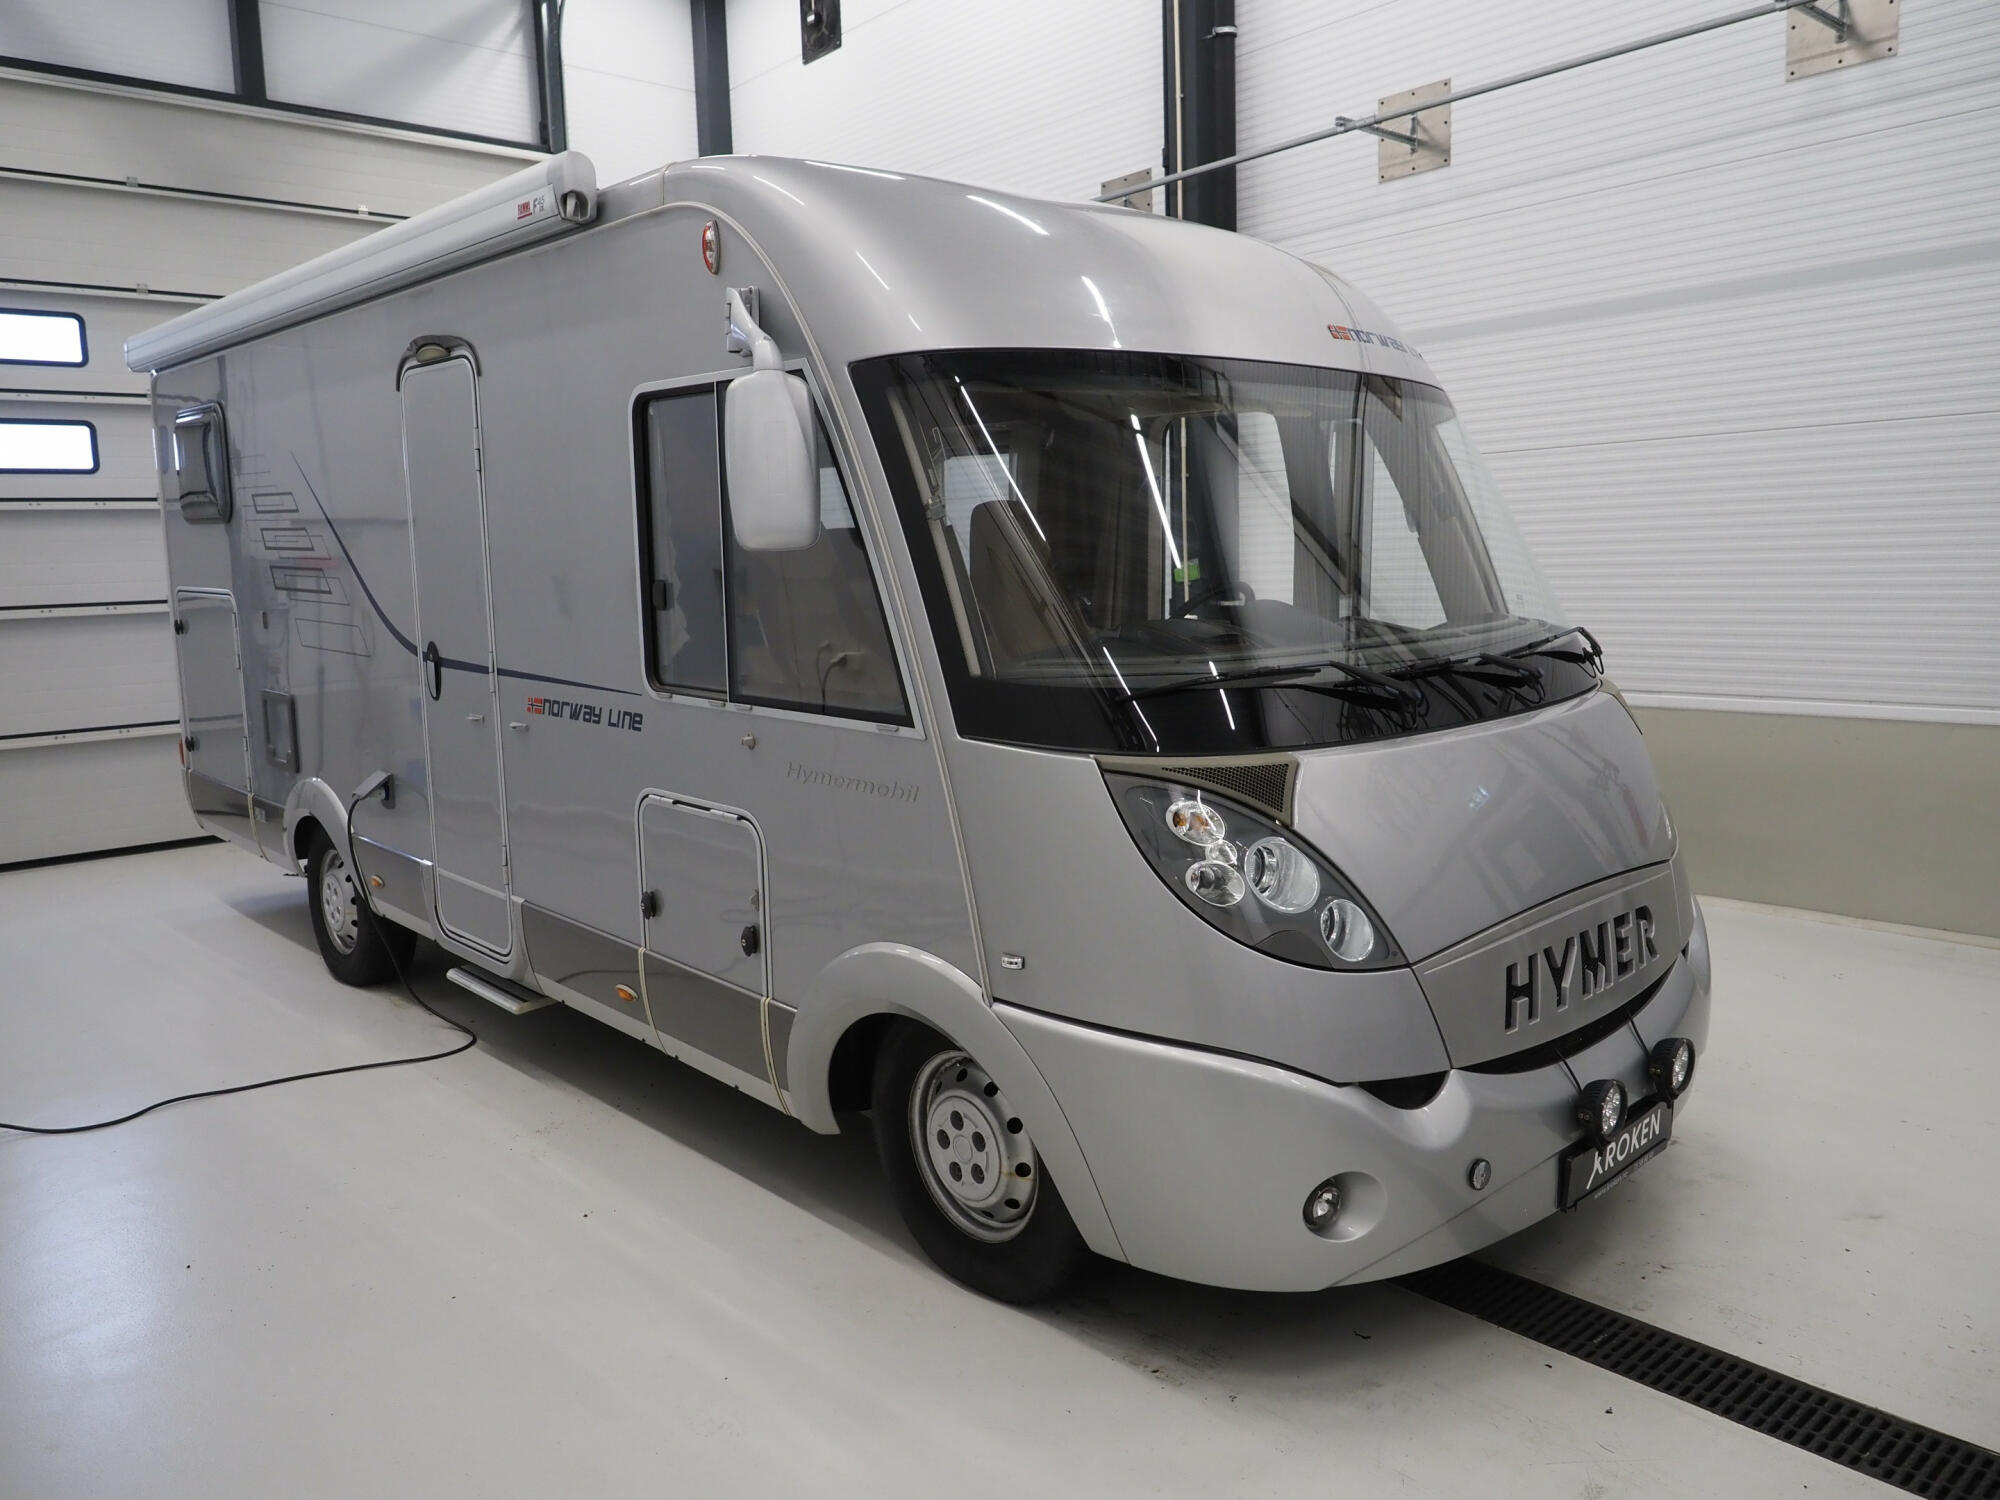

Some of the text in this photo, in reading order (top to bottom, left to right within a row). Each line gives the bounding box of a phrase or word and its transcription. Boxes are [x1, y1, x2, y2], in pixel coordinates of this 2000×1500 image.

[542, 698, 602, 725] norway
[785, 761, 920, 802] Hymermobil
[1504, 904, 1660, 1035] HYMER
[1586, 1108, 1661, 1190] KROKEN
